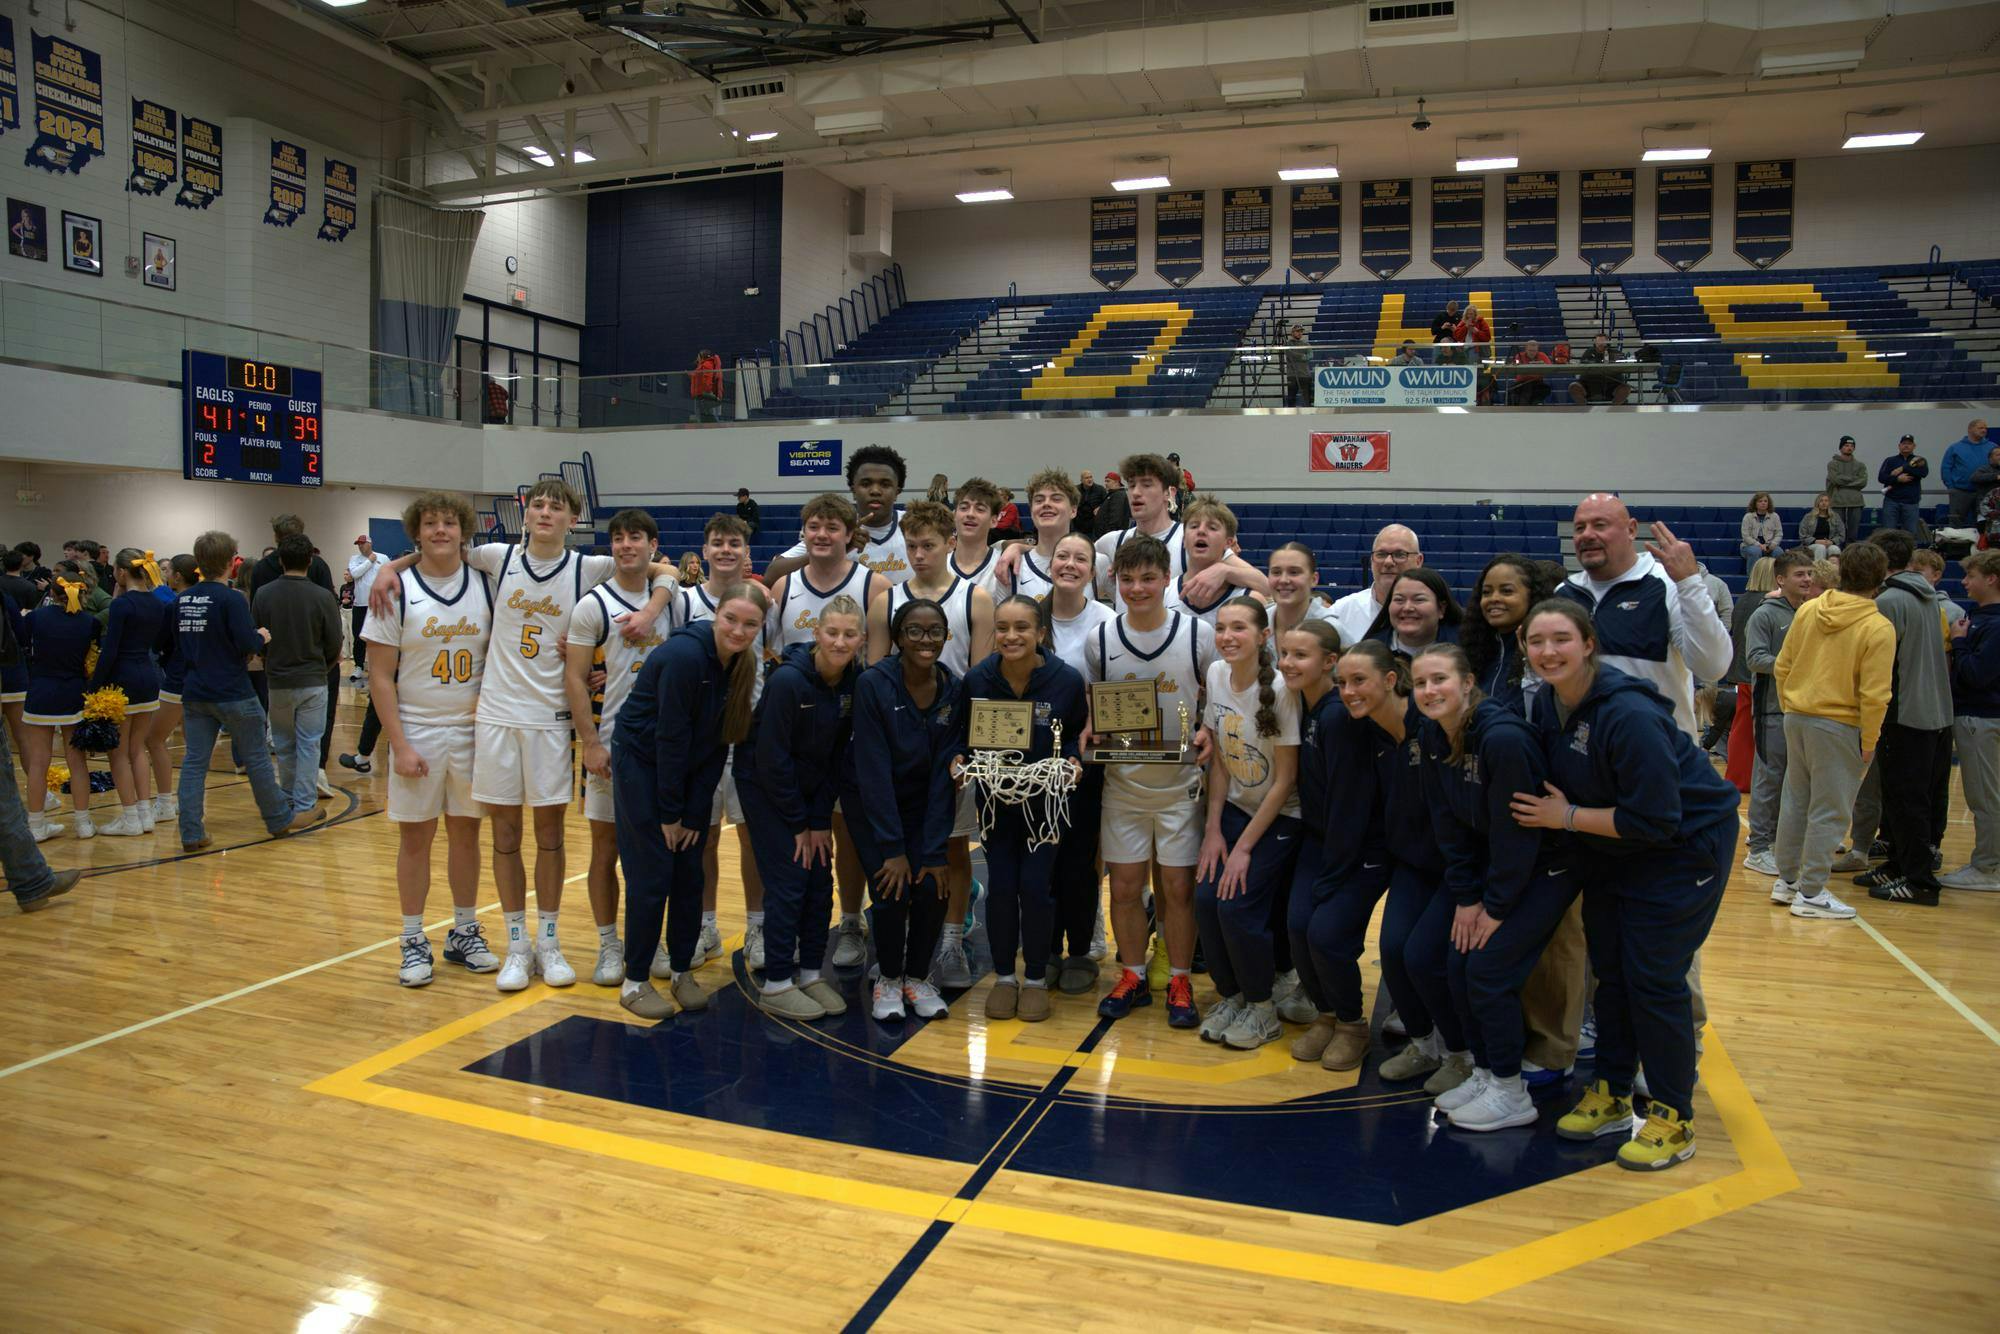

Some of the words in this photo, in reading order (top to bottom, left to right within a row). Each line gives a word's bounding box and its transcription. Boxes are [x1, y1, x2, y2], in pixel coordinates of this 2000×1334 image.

[36, 82, 102, 117] CHEERLEADING
[39, 110, 102, 151] 2024
[133, 131, 176, 154] VOLLEYBALL
[185, 148, 220, 167] FOOTBALL
[185, 166, 220, 191] 2001
[1323, 370, 1385, 386] WMUN
[1404, 370, 1467, 386] WMUN
[196, 386, 234, 403] EAGLES
[248, 401, 272, 411] PERIOD
[288, 400, 318, 414] GUEST
[203, 405, 232, 431] 41
[255, 414, 266, 433] 4
[195, 432, 217, 443] FOULS
[294, 416, 318, 441] 39
[240, 437, 265, 448] PLAYER
[266, 439, 282, 449] FOUL
[301, 444, 320, 453] FOULS
[203, 443, 216, 464] 2
[789, 451, 832, 459] VISITORS
[308, 454, 318, 473] 2
[789, 459, 830, 467] SEATING
[1335, 462, 1363, 470] RAIDERS
[195, 468, 218, 478] SCORE
[250, 472, 273, 482] MATCH
[301, 476, 320, 486] SCORE
[507, 588, 563, 618] Eagles
[421, 616, 481, 644] Eagles
[520, 624, 543, 659] 5
[431, 648, 472, 684] 40
